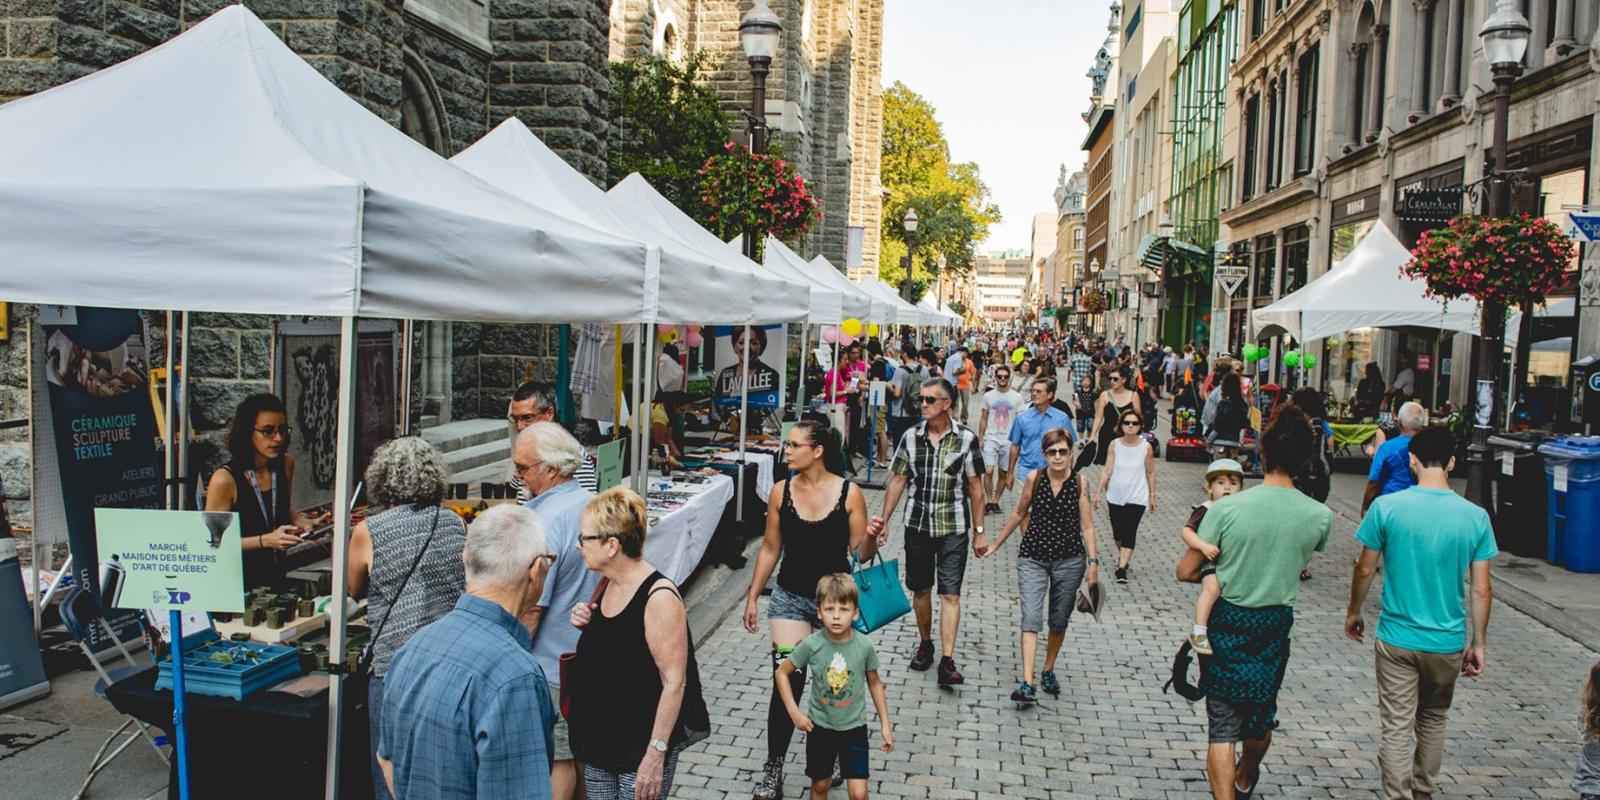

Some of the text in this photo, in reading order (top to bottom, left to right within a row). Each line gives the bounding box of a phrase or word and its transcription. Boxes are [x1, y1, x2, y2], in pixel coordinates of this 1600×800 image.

[722, 369, 772, 393] LAVLLÉE
[71, 413, 137, 432] CÉRAMIQUE
[73, 428, 131, 447] SCULPTURE
[74, 443, 113, 460] TEXTILE
[122, 466, 156, 480] ATELIERS
[94, 484, 158, 506] GRAND PUBLIC
[149, 541, 188, 551] MARCHÉ
[122, 552, 217, 563] MAISON DES MÉTIERS
[132, 562, 208, 573] D'ART DE QUÉBEC
[168, 591, 191, 605] XP
